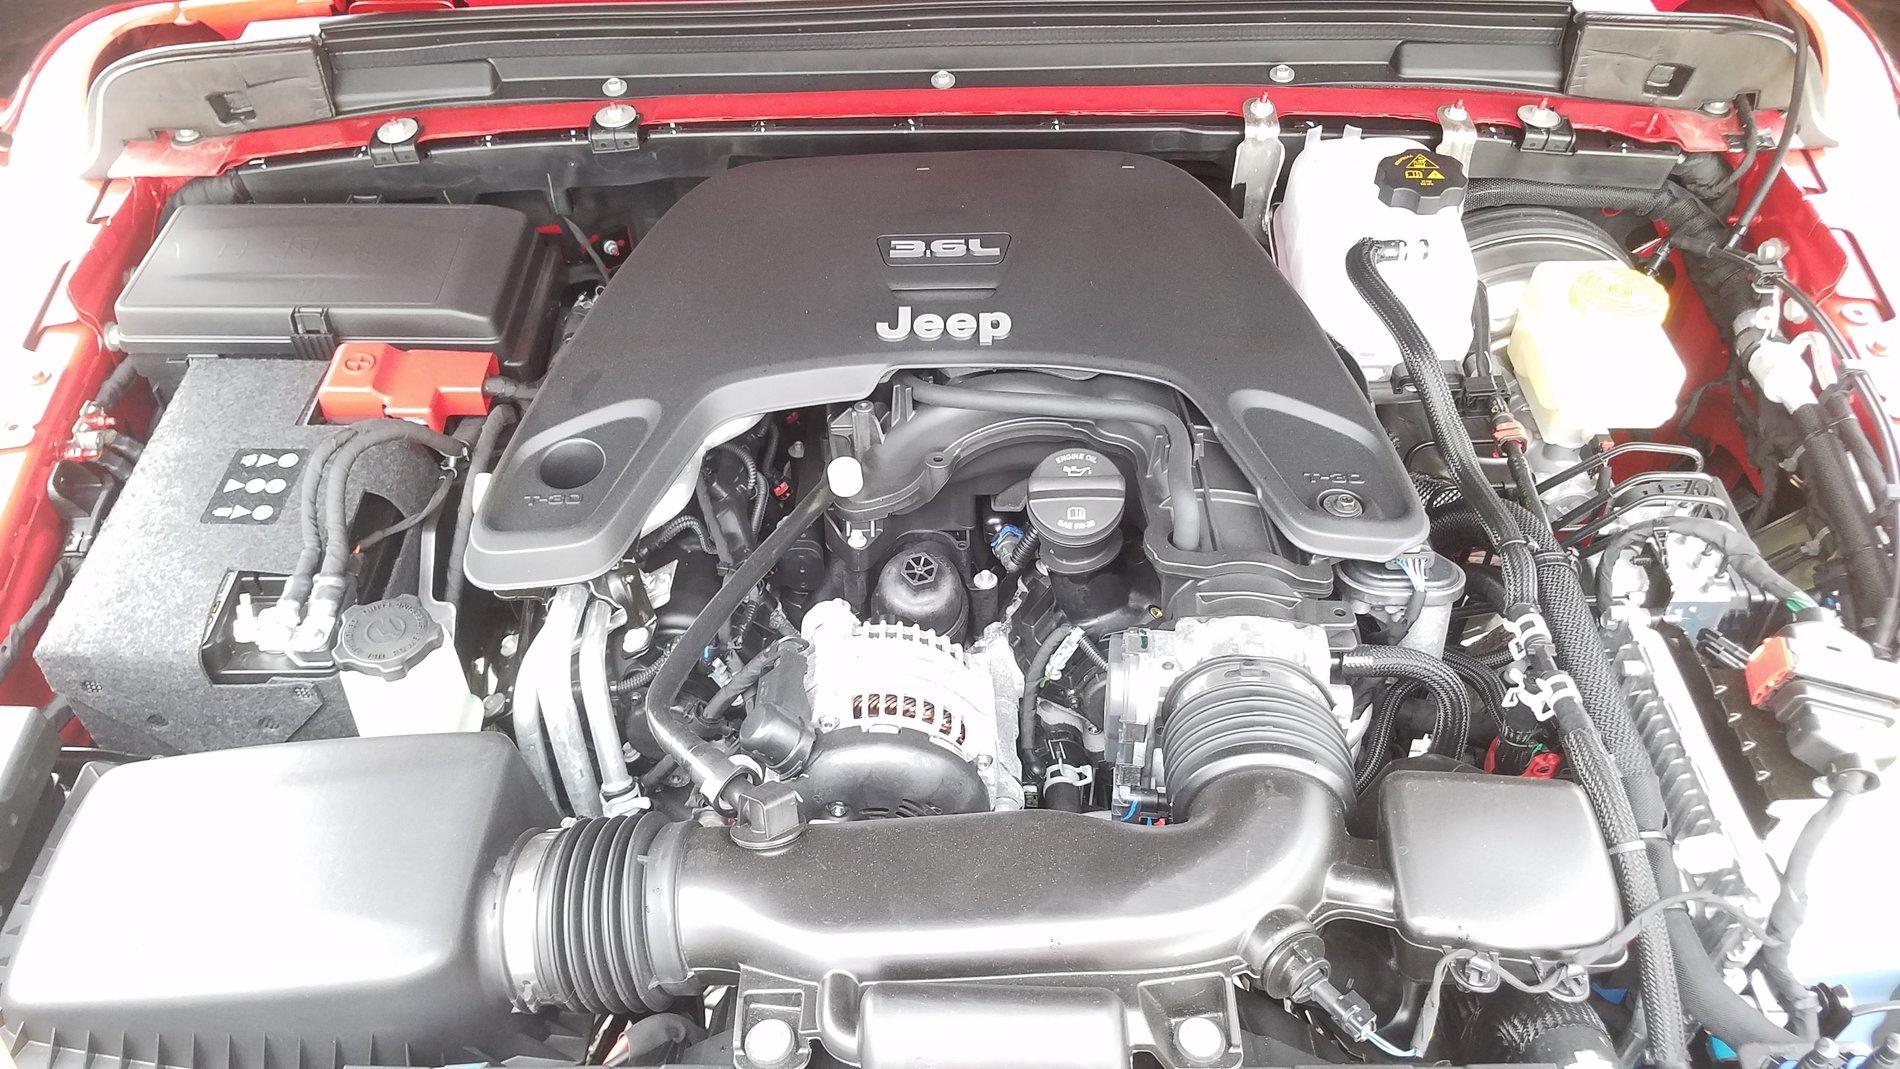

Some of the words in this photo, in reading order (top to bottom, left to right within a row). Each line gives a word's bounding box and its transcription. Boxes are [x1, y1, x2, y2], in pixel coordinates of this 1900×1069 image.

[889, 238, 1001, 258] 3.6L
[875, 305, 1012, 346] Jeep
[1055, 453, 1085, 464] ENGINE
[1085, 454, 1098, 464] OIL
[1057, 519, 1074, 530] SAE
